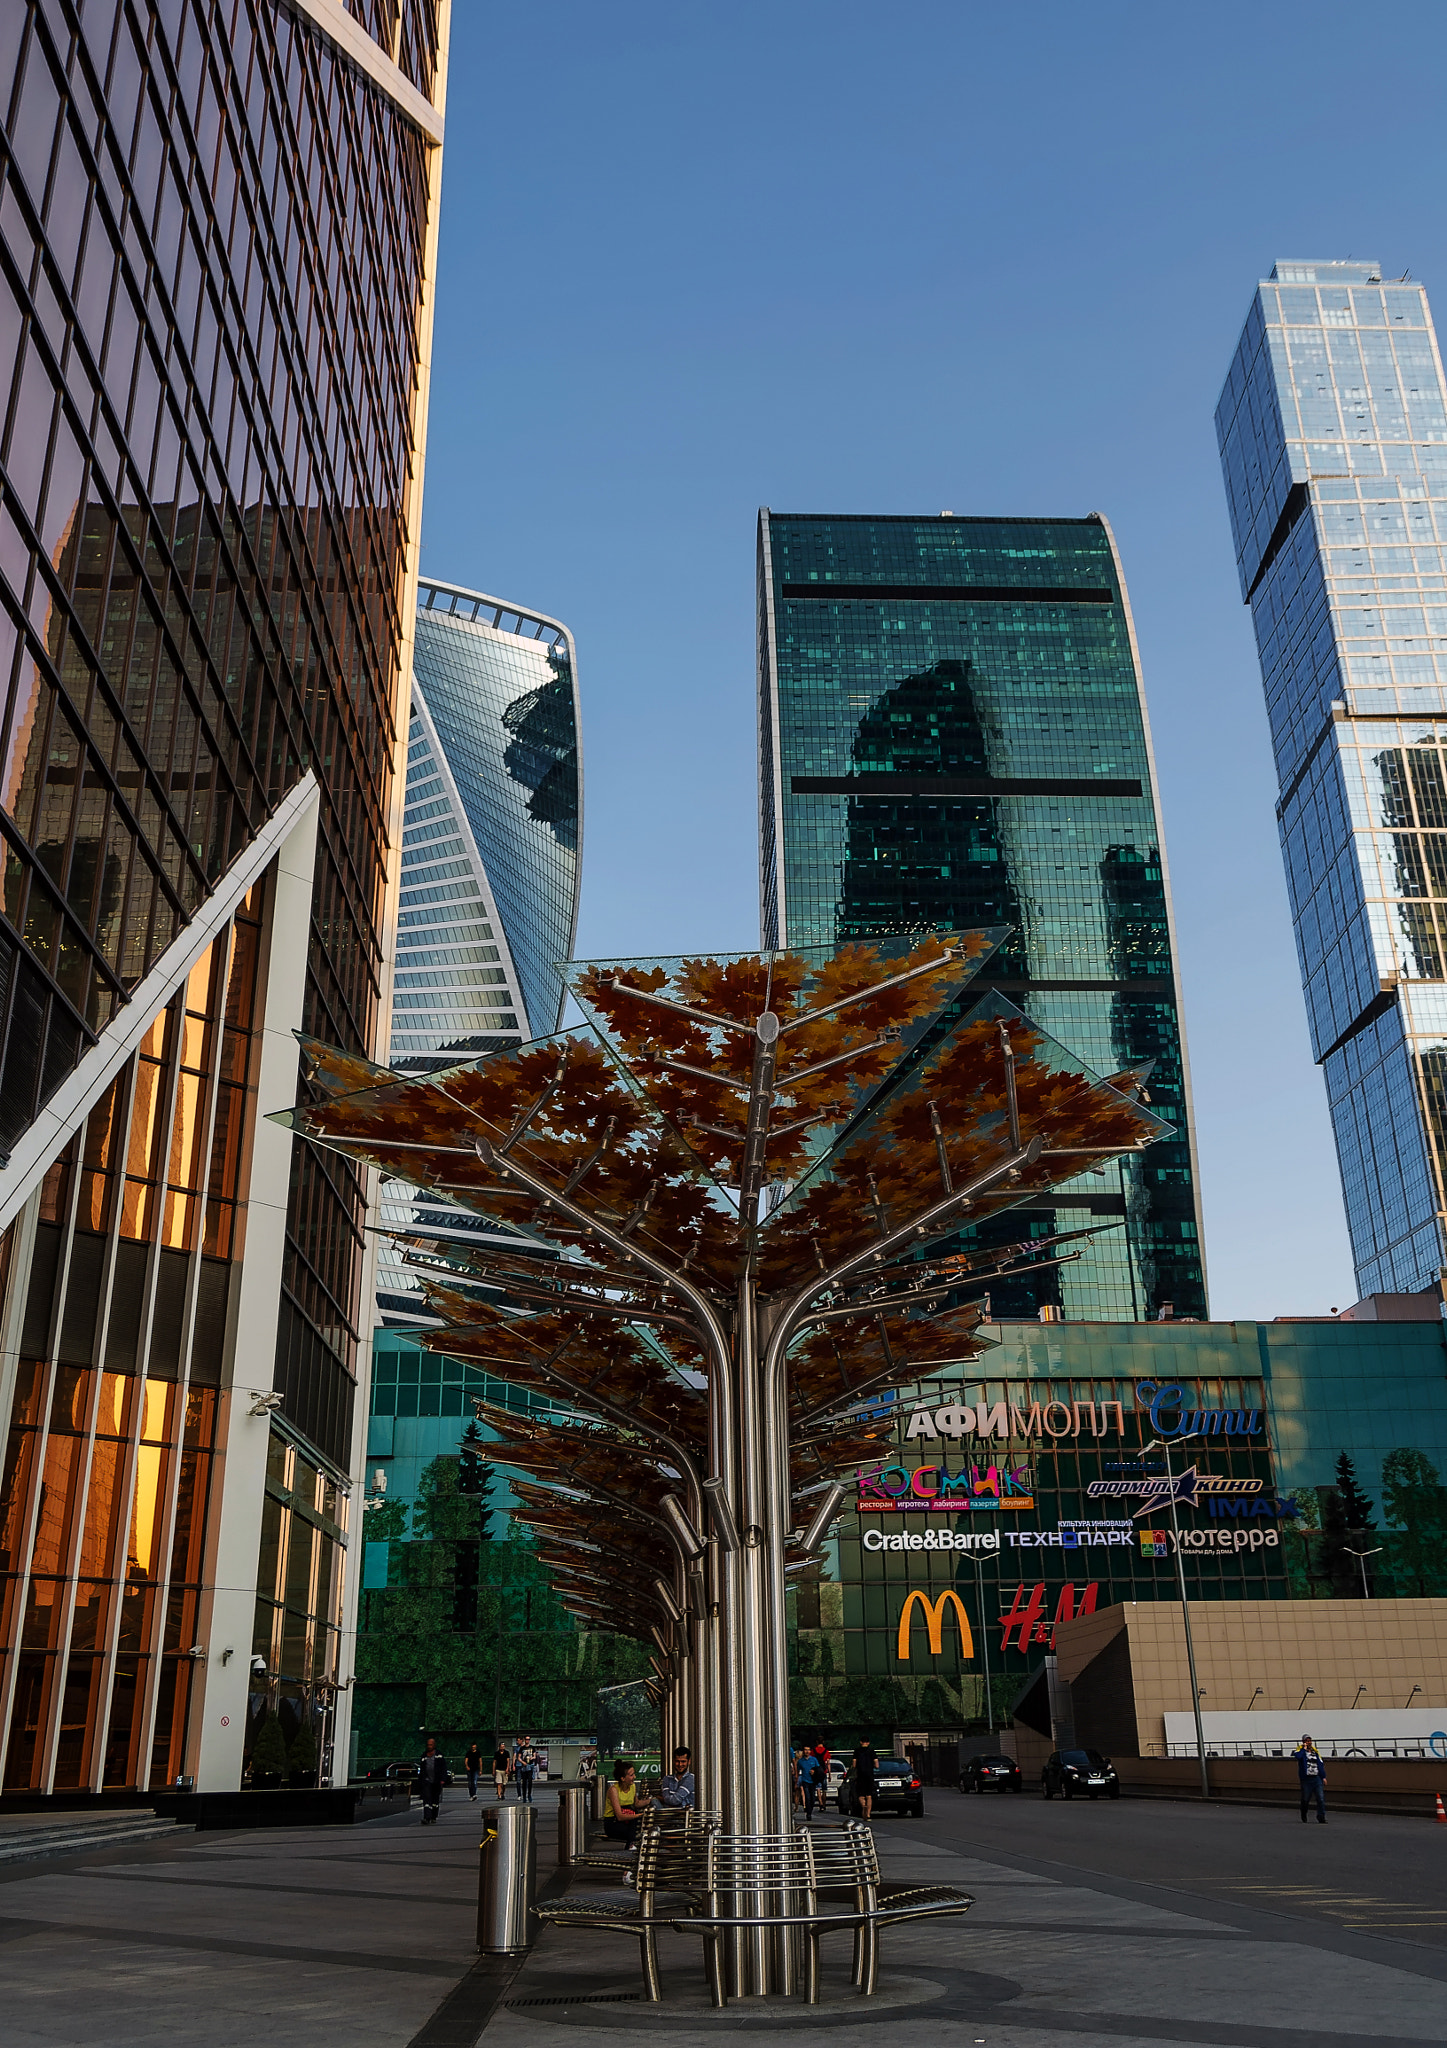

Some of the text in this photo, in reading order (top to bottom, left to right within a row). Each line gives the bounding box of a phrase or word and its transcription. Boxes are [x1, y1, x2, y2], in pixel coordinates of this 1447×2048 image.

[906, 1380, 1263, 1438] АФИМОЛЛ Сити
[857, 1464, 1034, 1498] КОСМИК
[859, 1502, 894, 1511] ресторан
[897, 1501, 930, 1511] игротека
[933, 1499, 968, 1510] лабиринт
[1208, 1497, 1301, 1518] IMAX
[863, 1528, 1000, 1551] Crate&Barrel
[1004, 1531, 1135, 1548] ТЕХНОПАРК
[1168, 1528, 1279, 1553] уютерра
